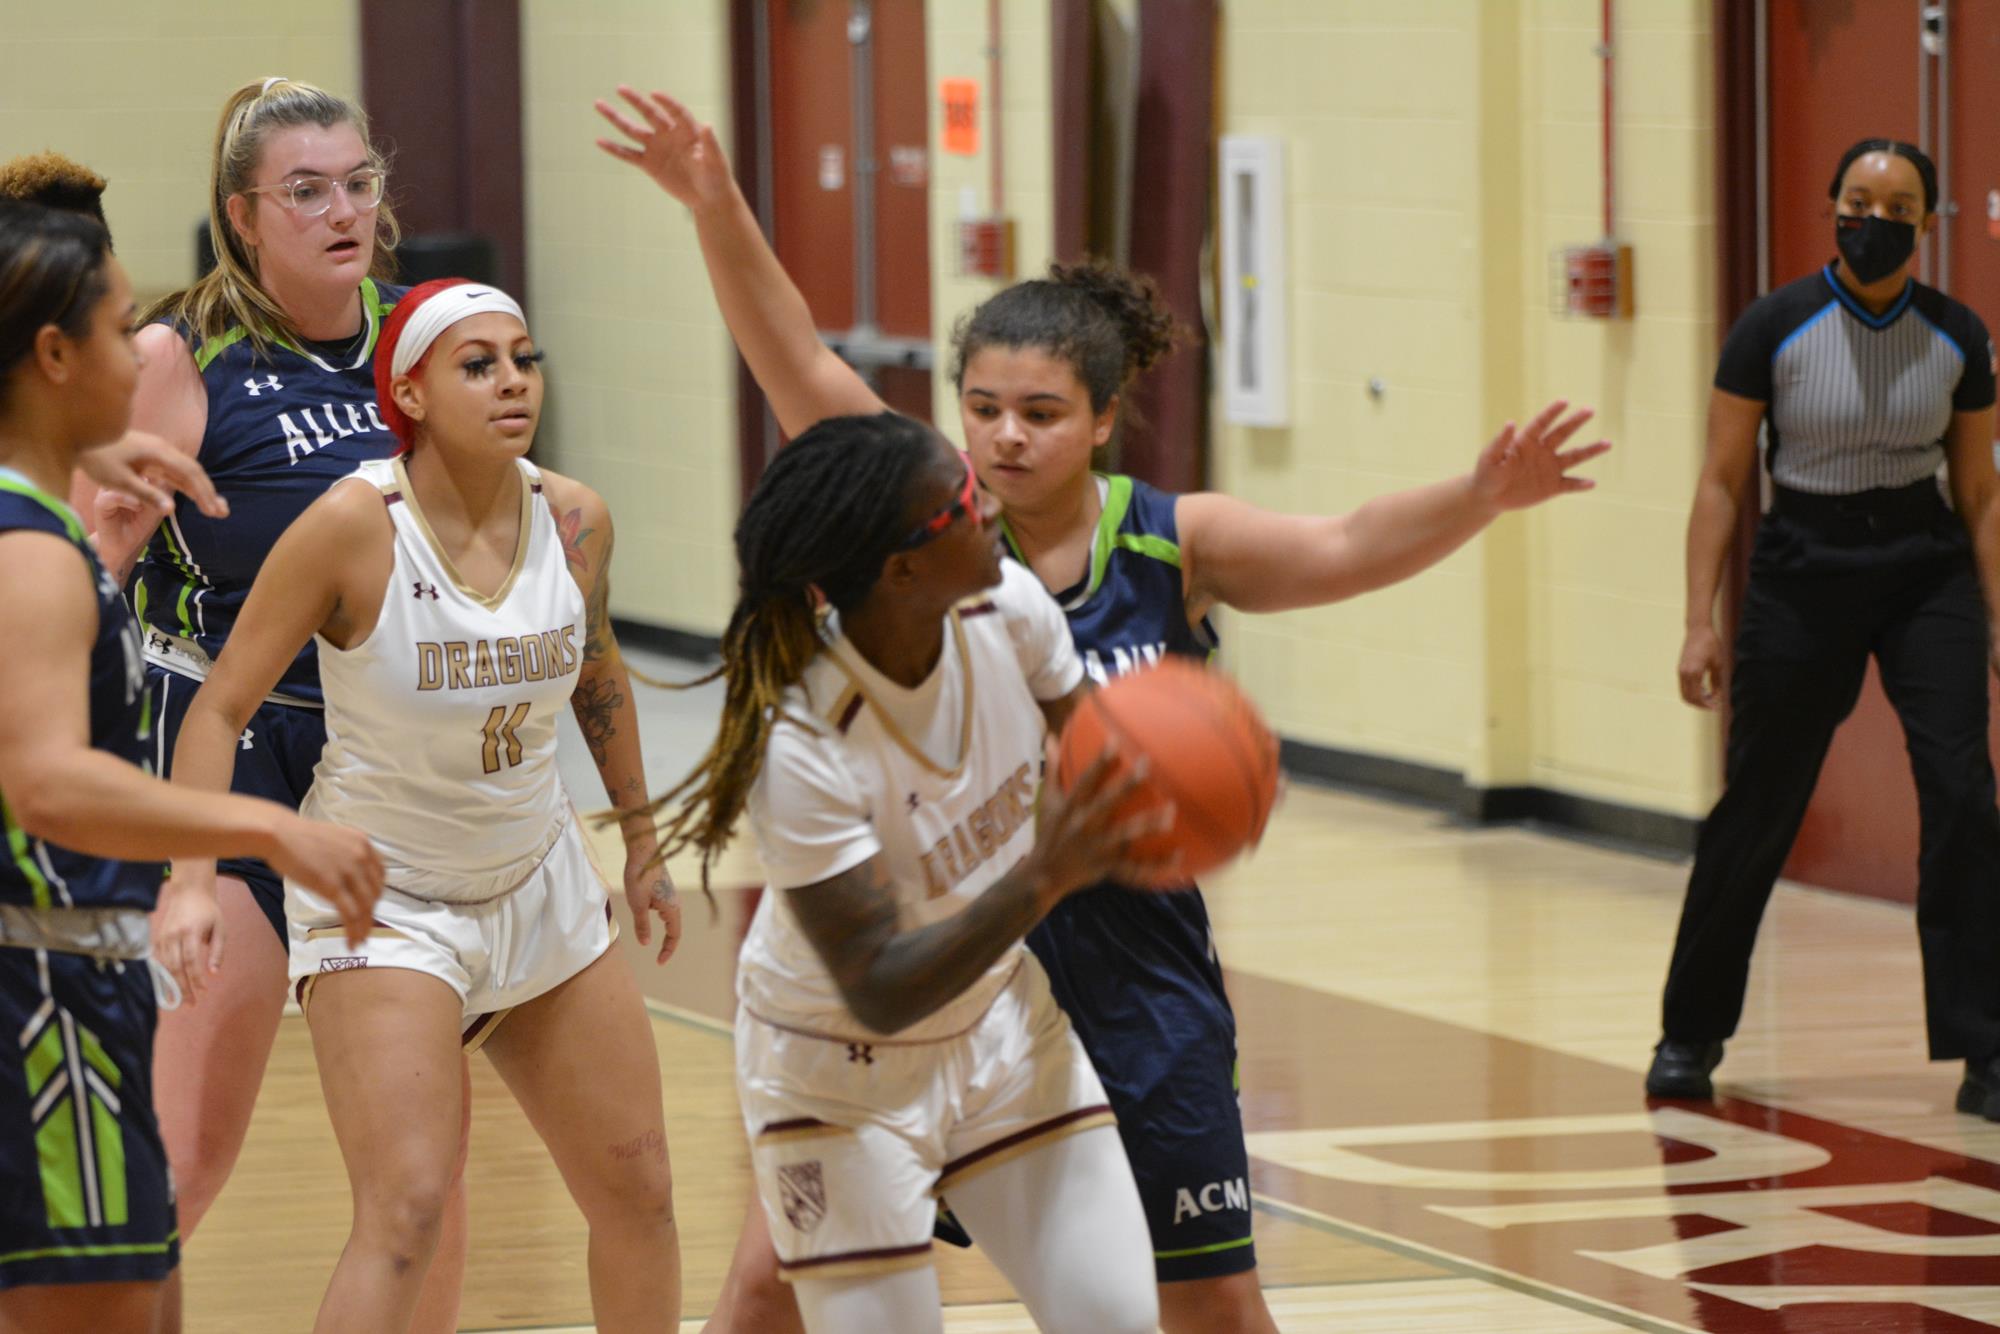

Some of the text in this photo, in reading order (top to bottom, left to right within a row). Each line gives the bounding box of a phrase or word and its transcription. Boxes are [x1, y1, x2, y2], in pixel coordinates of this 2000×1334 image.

[416, 624, 577, 691] DRAGONS
[481, 702, 531, 774] 11
[1173, 1177, 1249, 1225] ACM
